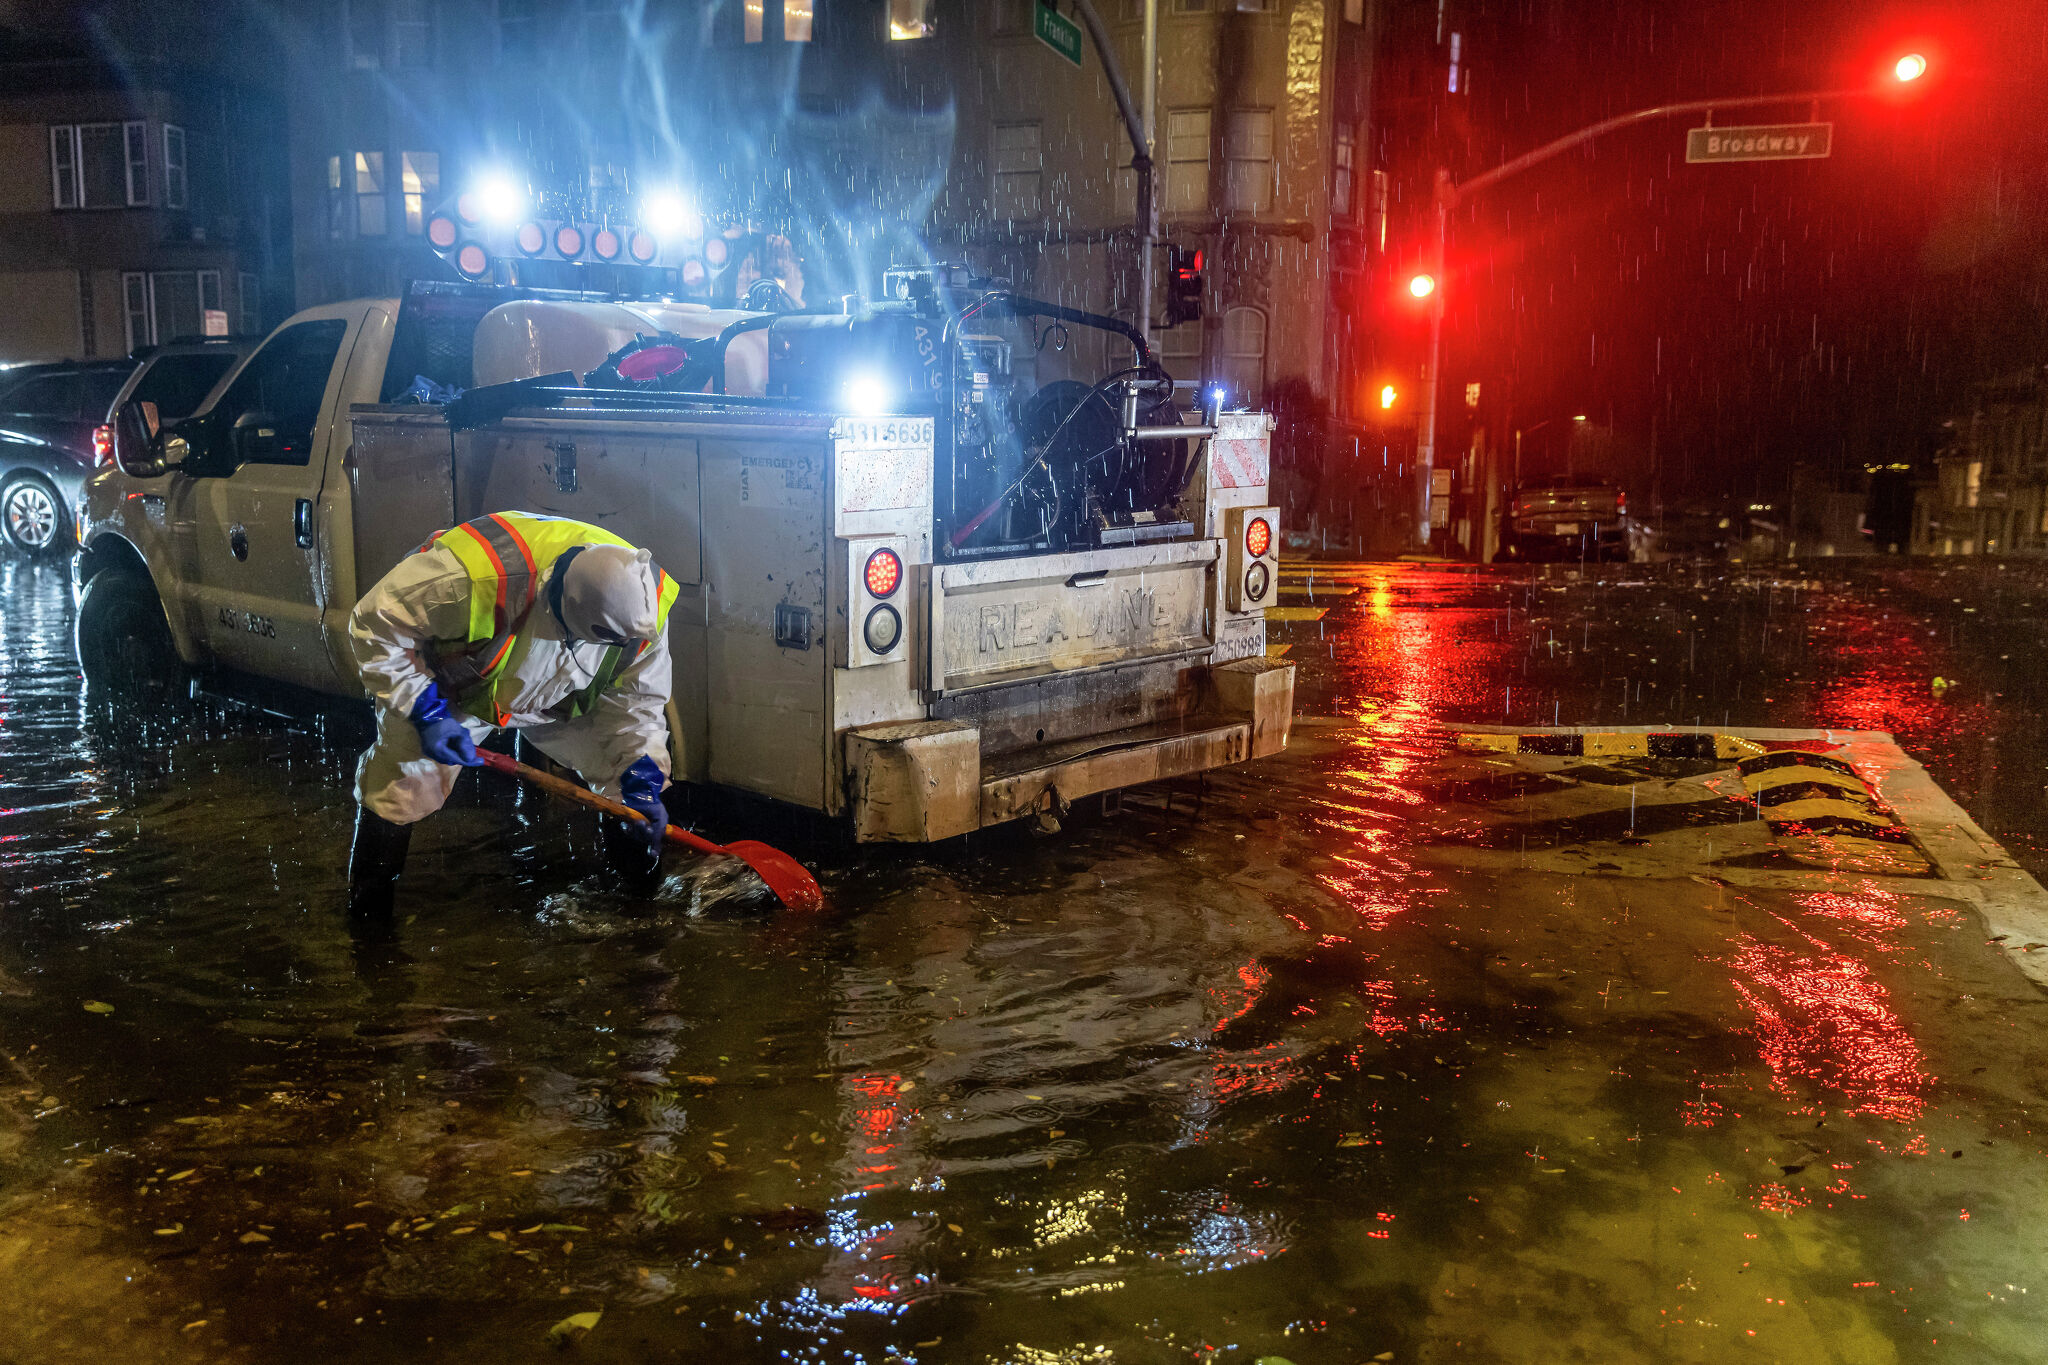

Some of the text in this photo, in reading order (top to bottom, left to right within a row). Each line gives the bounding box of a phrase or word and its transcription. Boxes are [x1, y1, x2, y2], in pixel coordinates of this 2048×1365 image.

[1044, 12, 1074, 52] Franklin
[1707, 133, 1810, 154] Broadway
[979, 585, 1176, 652] READING
